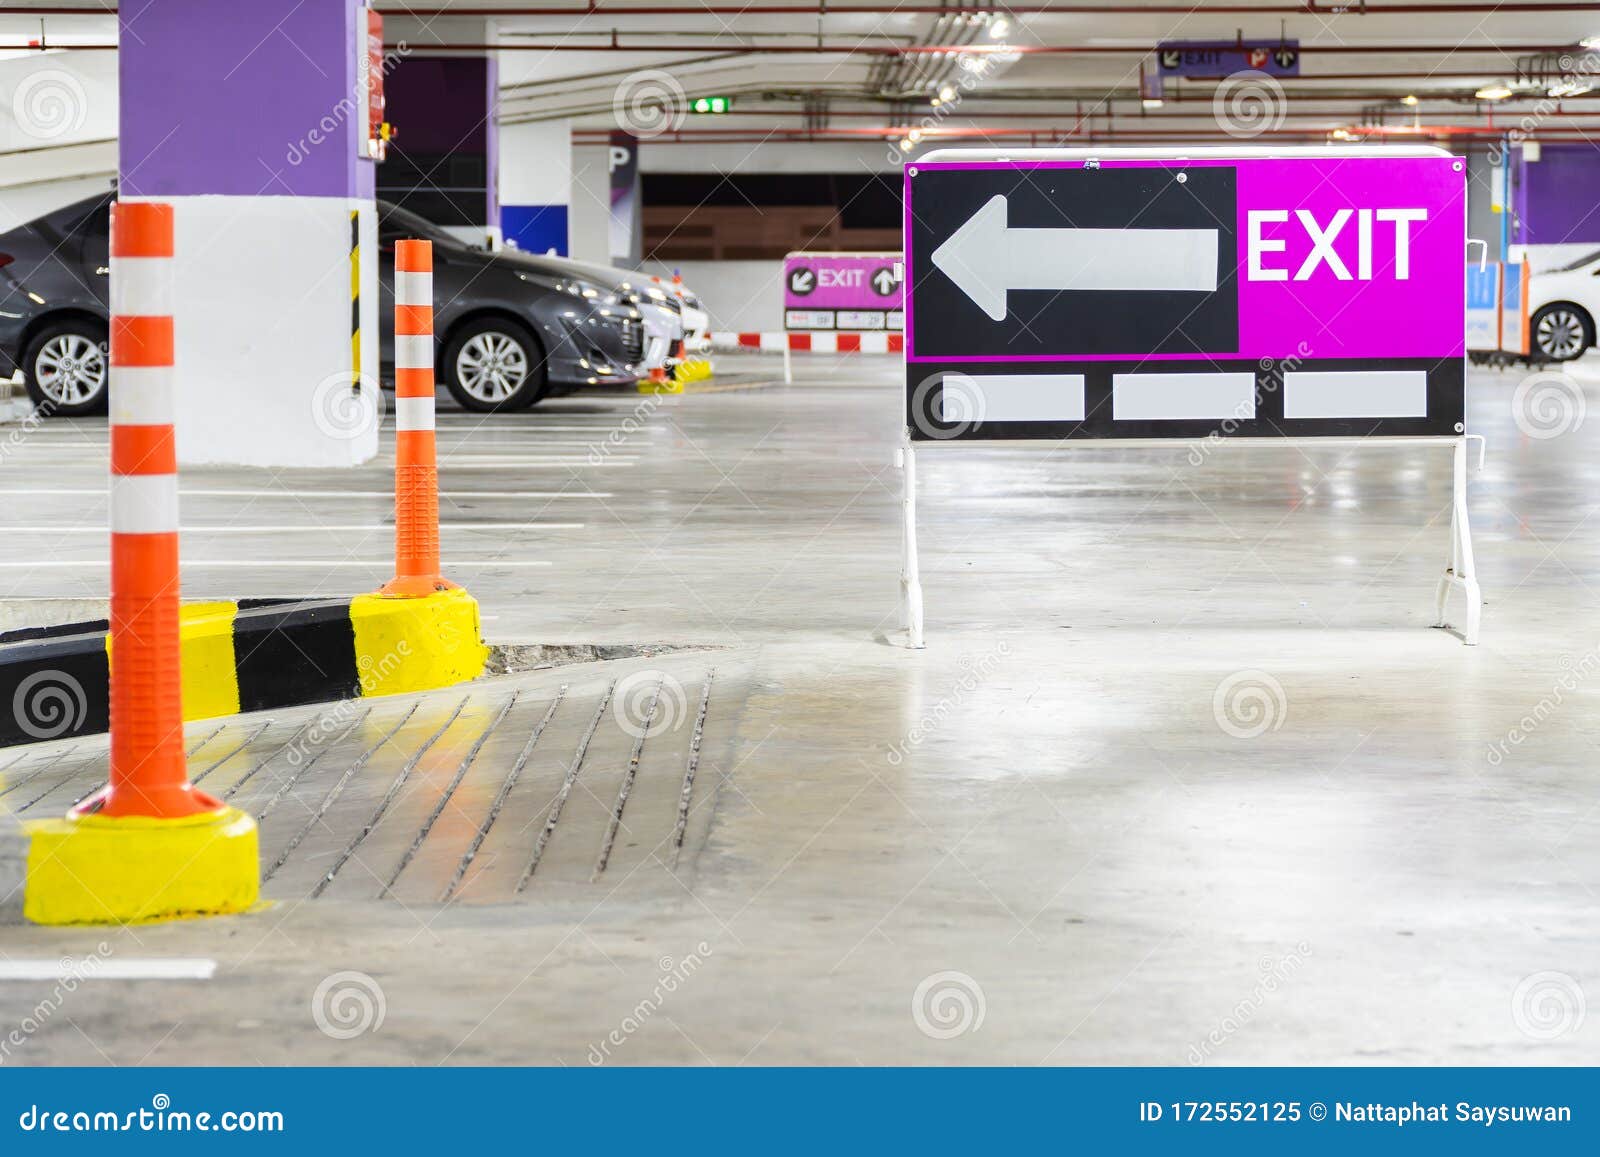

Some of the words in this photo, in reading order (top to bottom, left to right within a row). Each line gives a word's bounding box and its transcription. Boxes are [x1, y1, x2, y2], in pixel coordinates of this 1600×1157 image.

[609, 147, 630, 172] P
[1248, 208, 1427, 281] EXIT
[818, 269, 864, 287] EXIT
